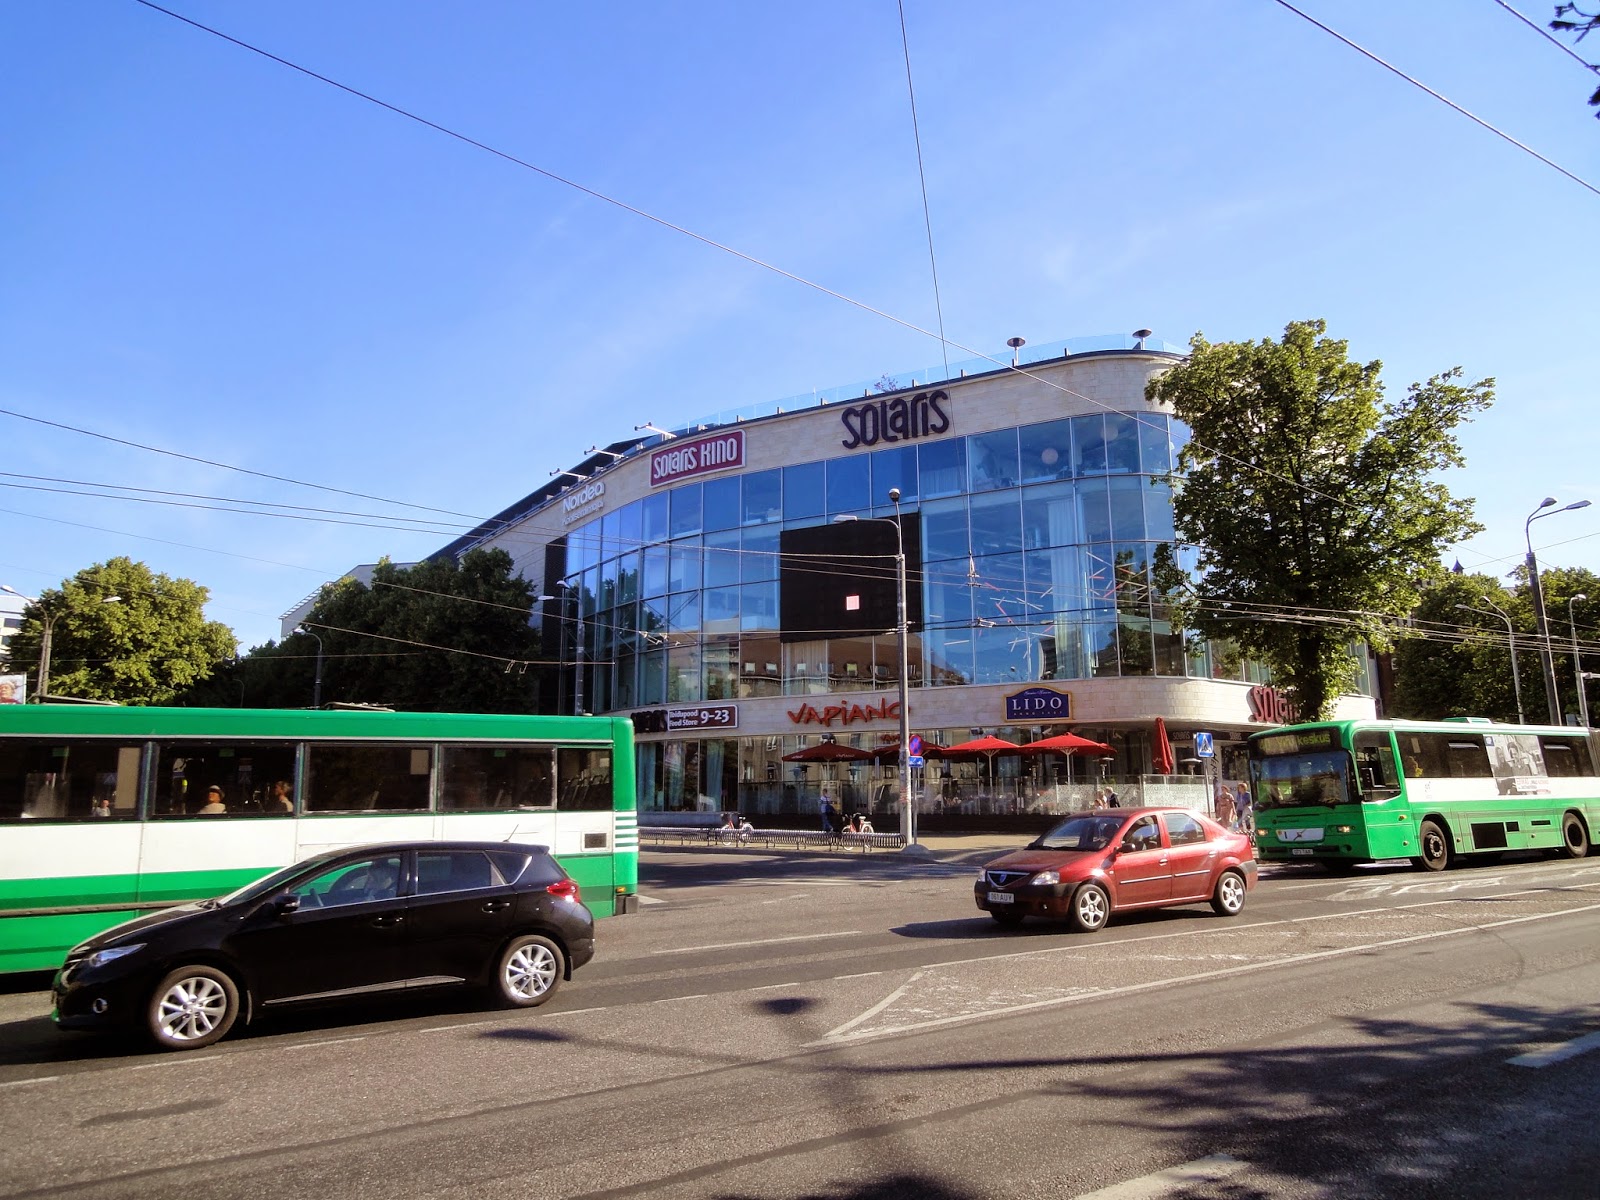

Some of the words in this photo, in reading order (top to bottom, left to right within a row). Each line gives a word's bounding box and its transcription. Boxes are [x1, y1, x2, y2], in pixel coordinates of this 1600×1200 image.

[700, 438, 738, 467] KINO
[563, 482, 605, 514] Nordea
[787, 697, 911, 727] VAPIANO
[1012, 696, 1062, 711] LIDO
[700, 709, 730, 724] 9-23
[1297, 731, 1331, 746] keskus
